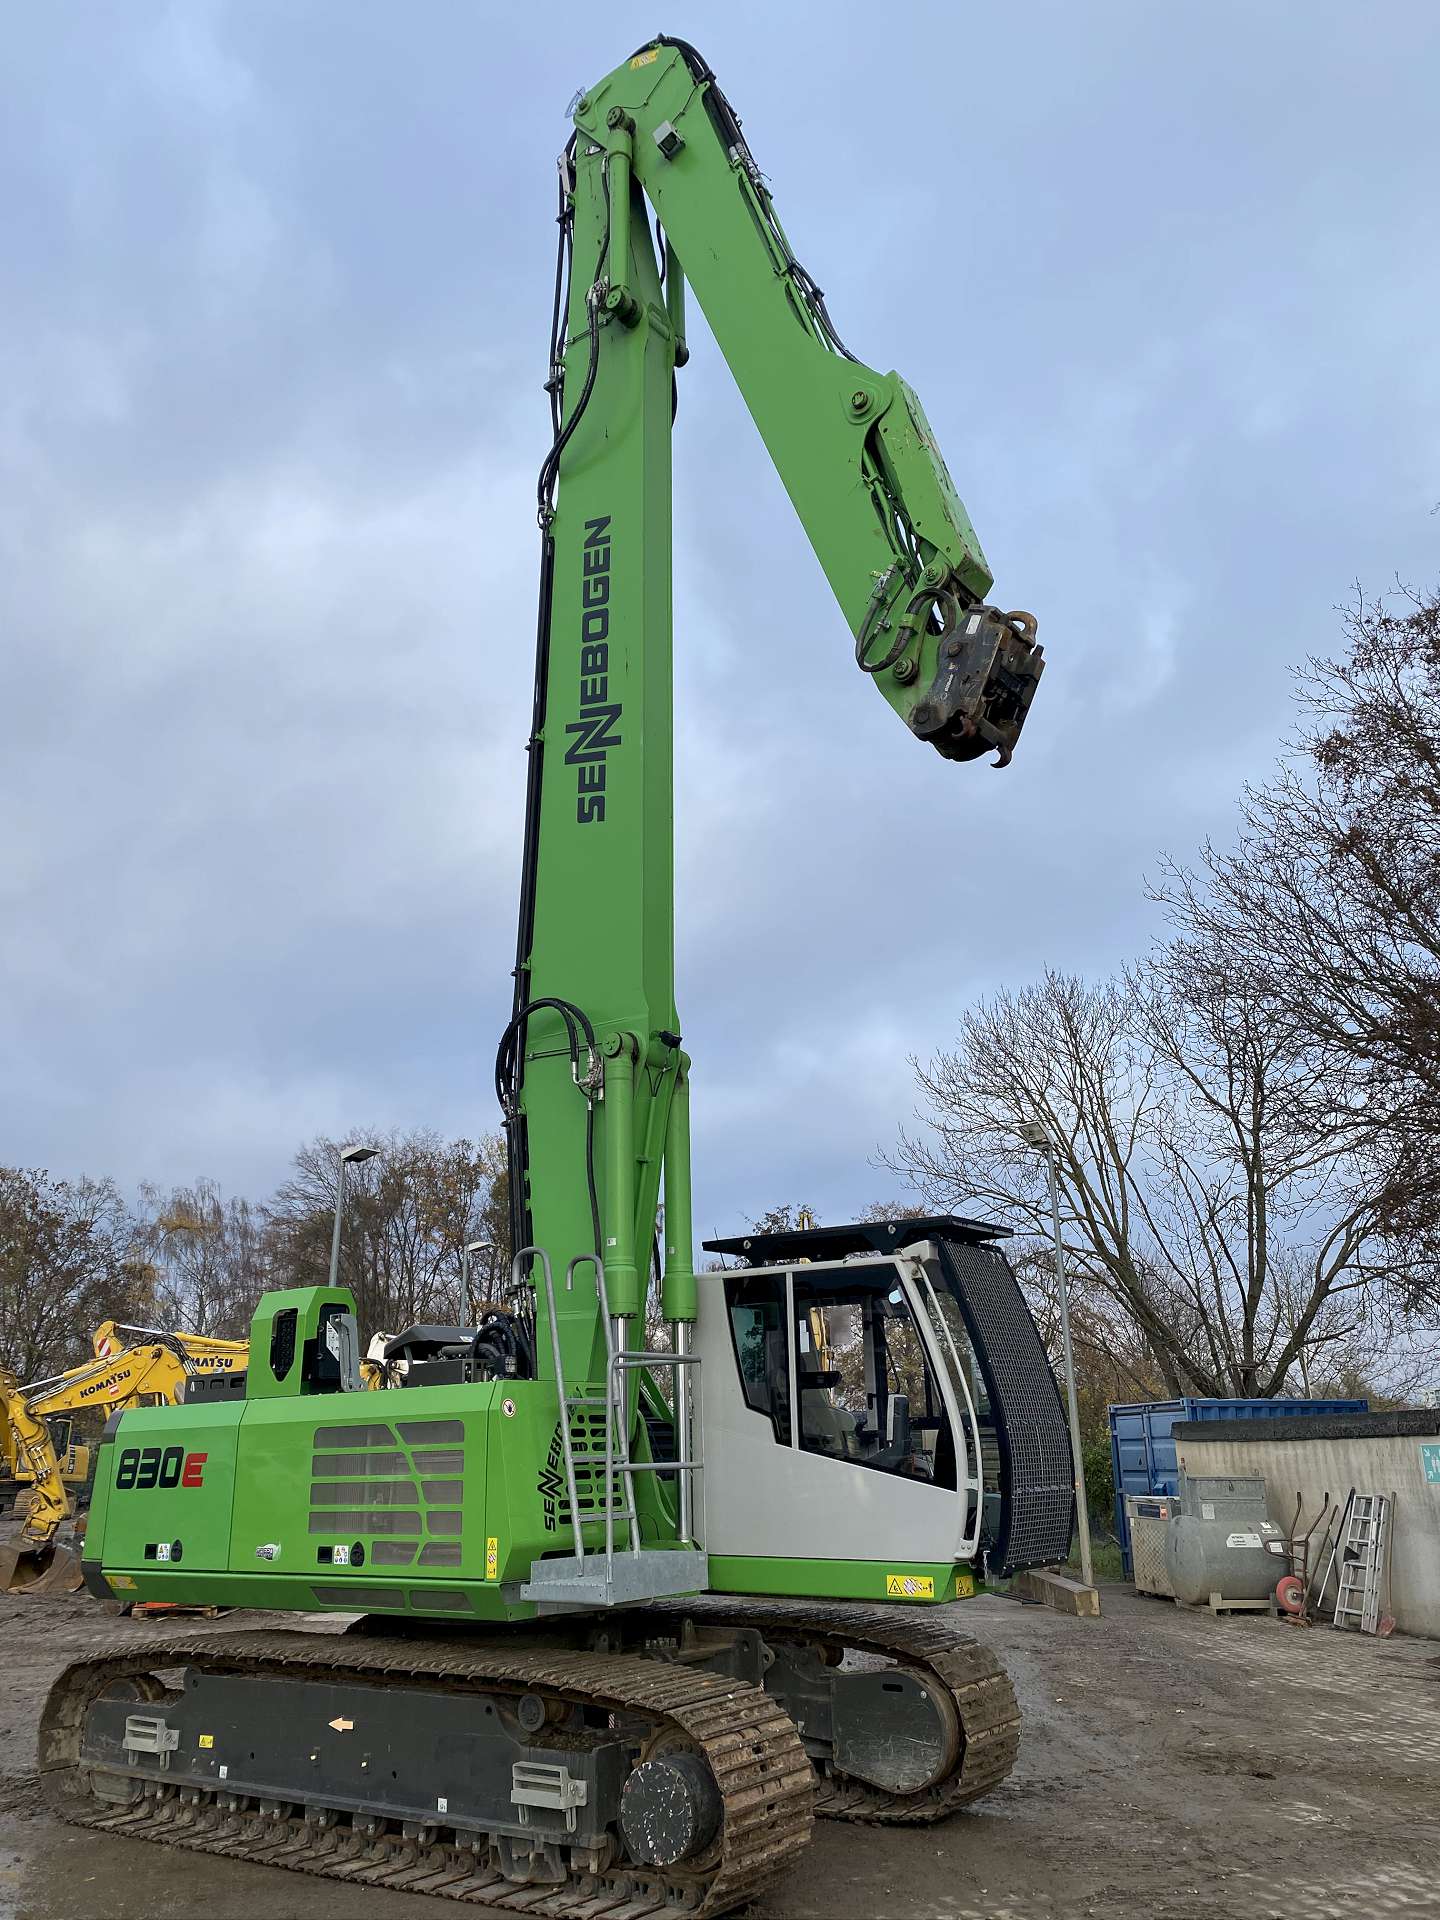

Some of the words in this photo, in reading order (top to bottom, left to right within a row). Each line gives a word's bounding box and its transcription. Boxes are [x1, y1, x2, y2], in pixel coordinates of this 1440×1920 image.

[564, 515, 622, 824] SENNEBOGEN
[79, 1369, 131, 1398] KOMATSU
[116, 1446, 208, 1490] 830E
